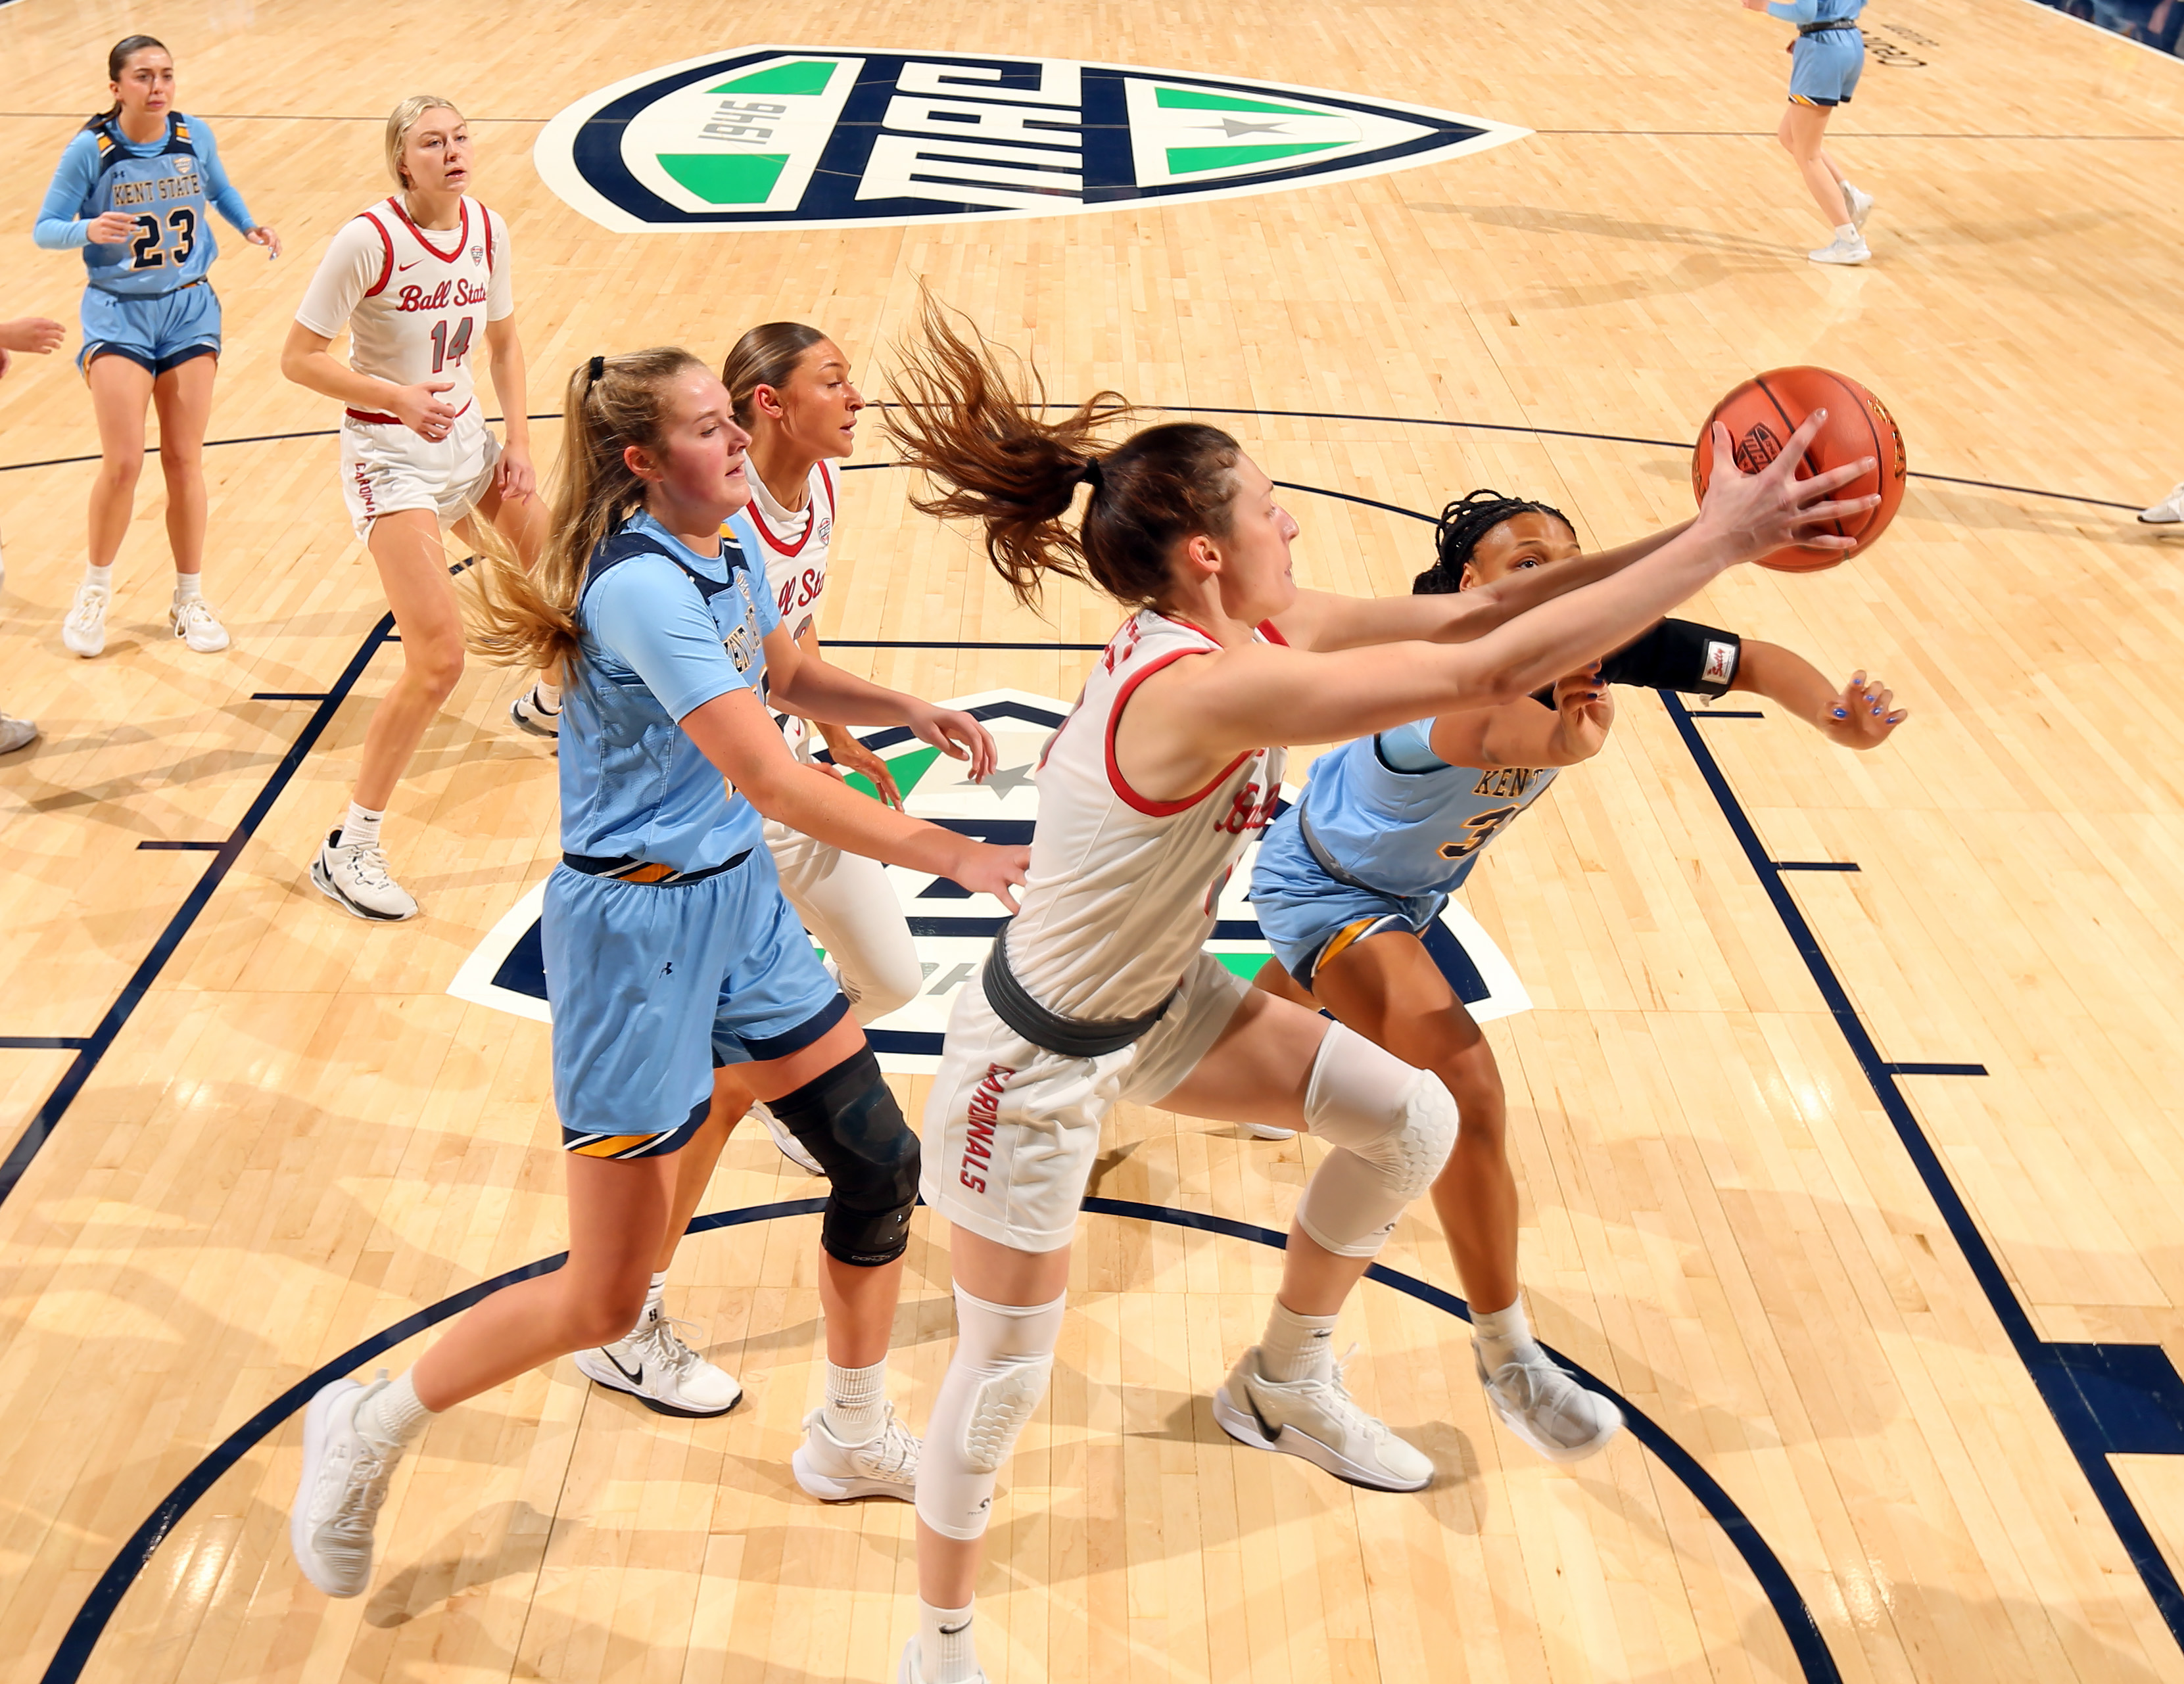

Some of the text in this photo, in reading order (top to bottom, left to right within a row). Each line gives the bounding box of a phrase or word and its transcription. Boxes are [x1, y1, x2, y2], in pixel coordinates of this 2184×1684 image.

[698, 100, 787, 145] 1946
[854, 61, 1083, 211] MAC
[112, 174, 201, 207] KENT STATE
[130, 206, 197, 271] 23
[396, 279, 452, 312] Ball
[431, 316, 473, 374] 14
[1471, 768, 1544, 798] KENT
[959, 1062, 1017, 1194] CARDINALS
